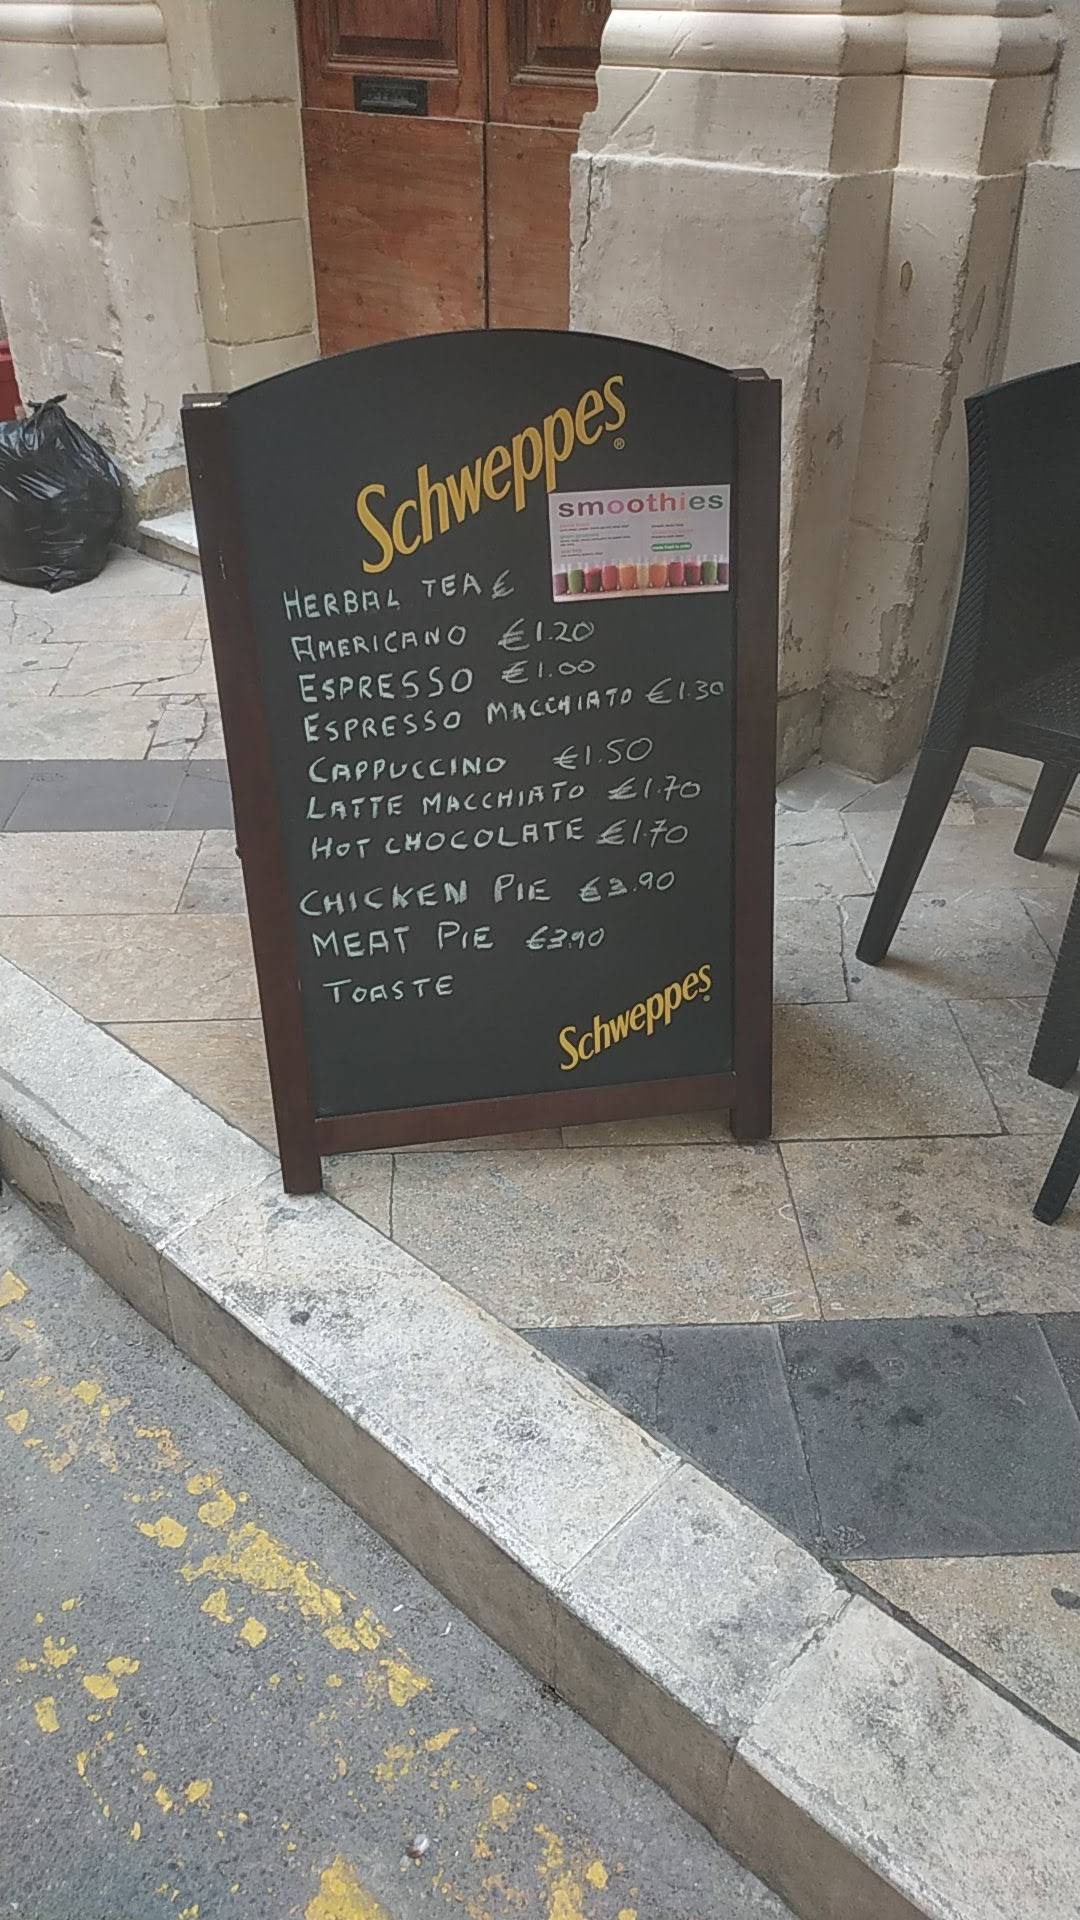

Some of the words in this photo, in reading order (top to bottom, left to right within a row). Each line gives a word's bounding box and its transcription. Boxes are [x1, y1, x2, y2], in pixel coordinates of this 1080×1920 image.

[356, 375, 626, 574] Schweppes
[558, 491, 724, 518] smoothies
[283, 585, 400, 621] HERBAL
[422, 573, 482, 598] TEA
[291, 625, 466, 662] AMERICANO
[498, 618, 594, 651] €1.20
[299, 666, 473, 702] ESPRESSO
[502, 660, 596, 684] €1.00
[304, 710, 461, 742] ESPRESSO
[487, 687, 632, 724] MACCHIATO
[646, 678, 724, 704] €1.30
[308, 756, 506, 783] CAPPUCCINO
[553, 737, 653, 770] €1.50
[306, 795, 403, 820] LATTE
[422, 781, 585, 815] MACCHIATO
[608, 775, 701, 801] €1.70
[311, 836, 370, 860] HOT
[385, 818, 584, 855] CHOCOLATE
[595, 819, 689, 848] €1.70
[299, 880, 467, 916] CHICKEN
[494, 873, 551, 903] PIE
[312, 925, 410, 957] MEAT
[438, 921, 493, 950] PIE
[322, 975, 453, 1003] TOASTE
[558, 964, 712, 1071] Schweppes
